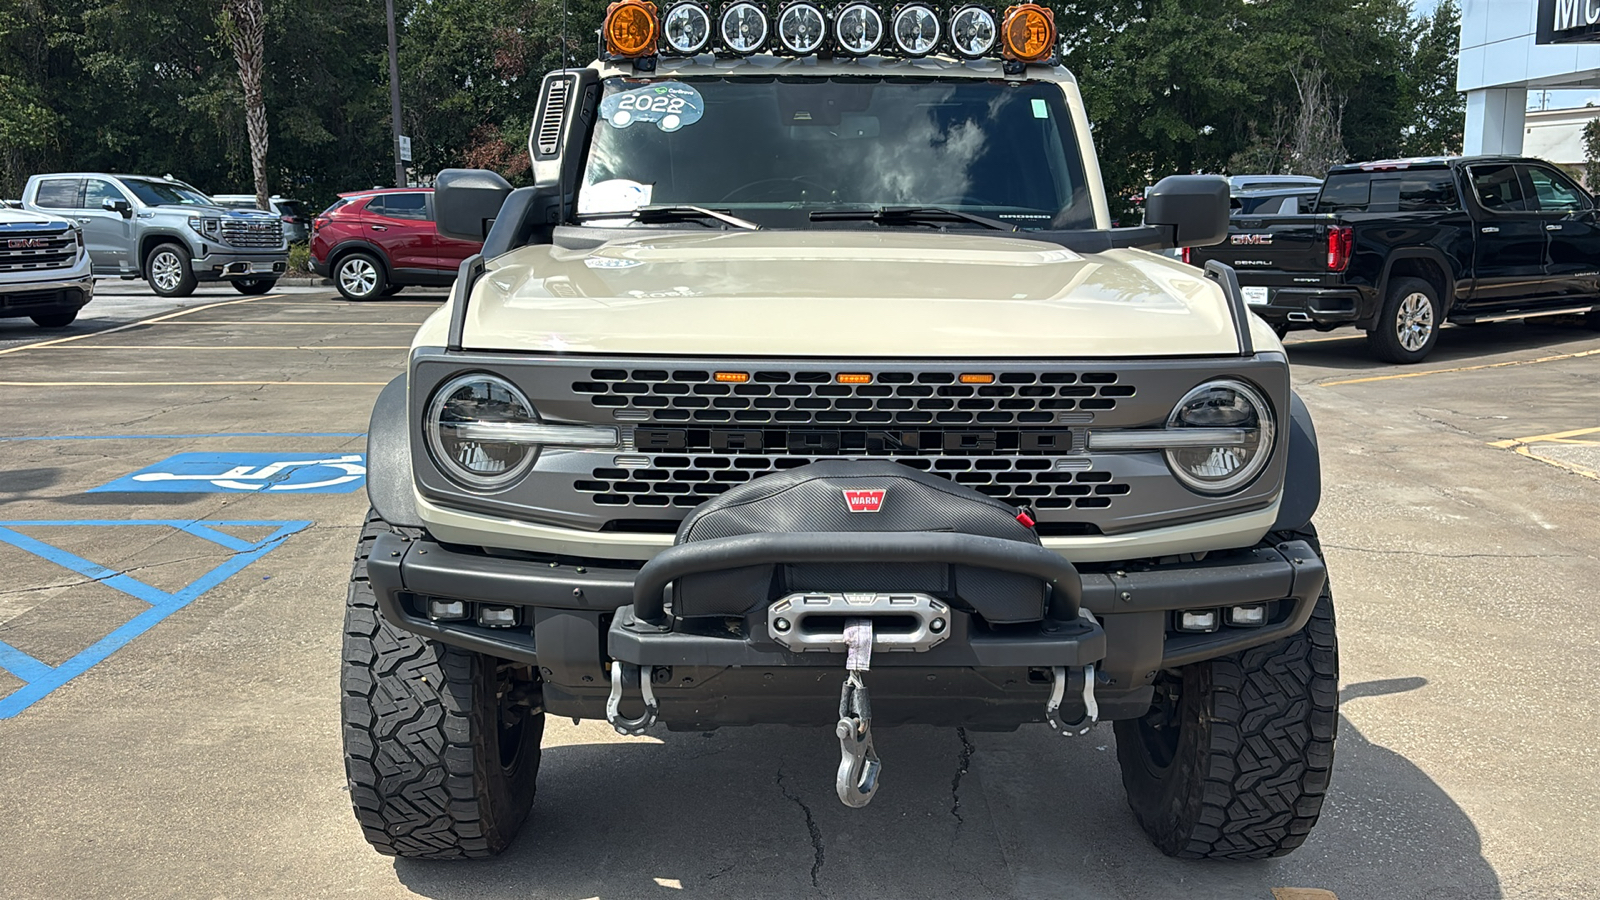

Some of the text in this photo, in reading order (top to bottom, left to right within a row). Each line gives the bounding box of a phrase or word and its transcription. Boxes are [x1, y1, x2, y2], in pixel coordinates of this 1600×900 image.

[8, 239, 49, 248] GMC
[1231, 234, 1273, 245] GMC
[633, 427, 1073, 453] BRONCO
[850, 496, 879, 505] WARN
